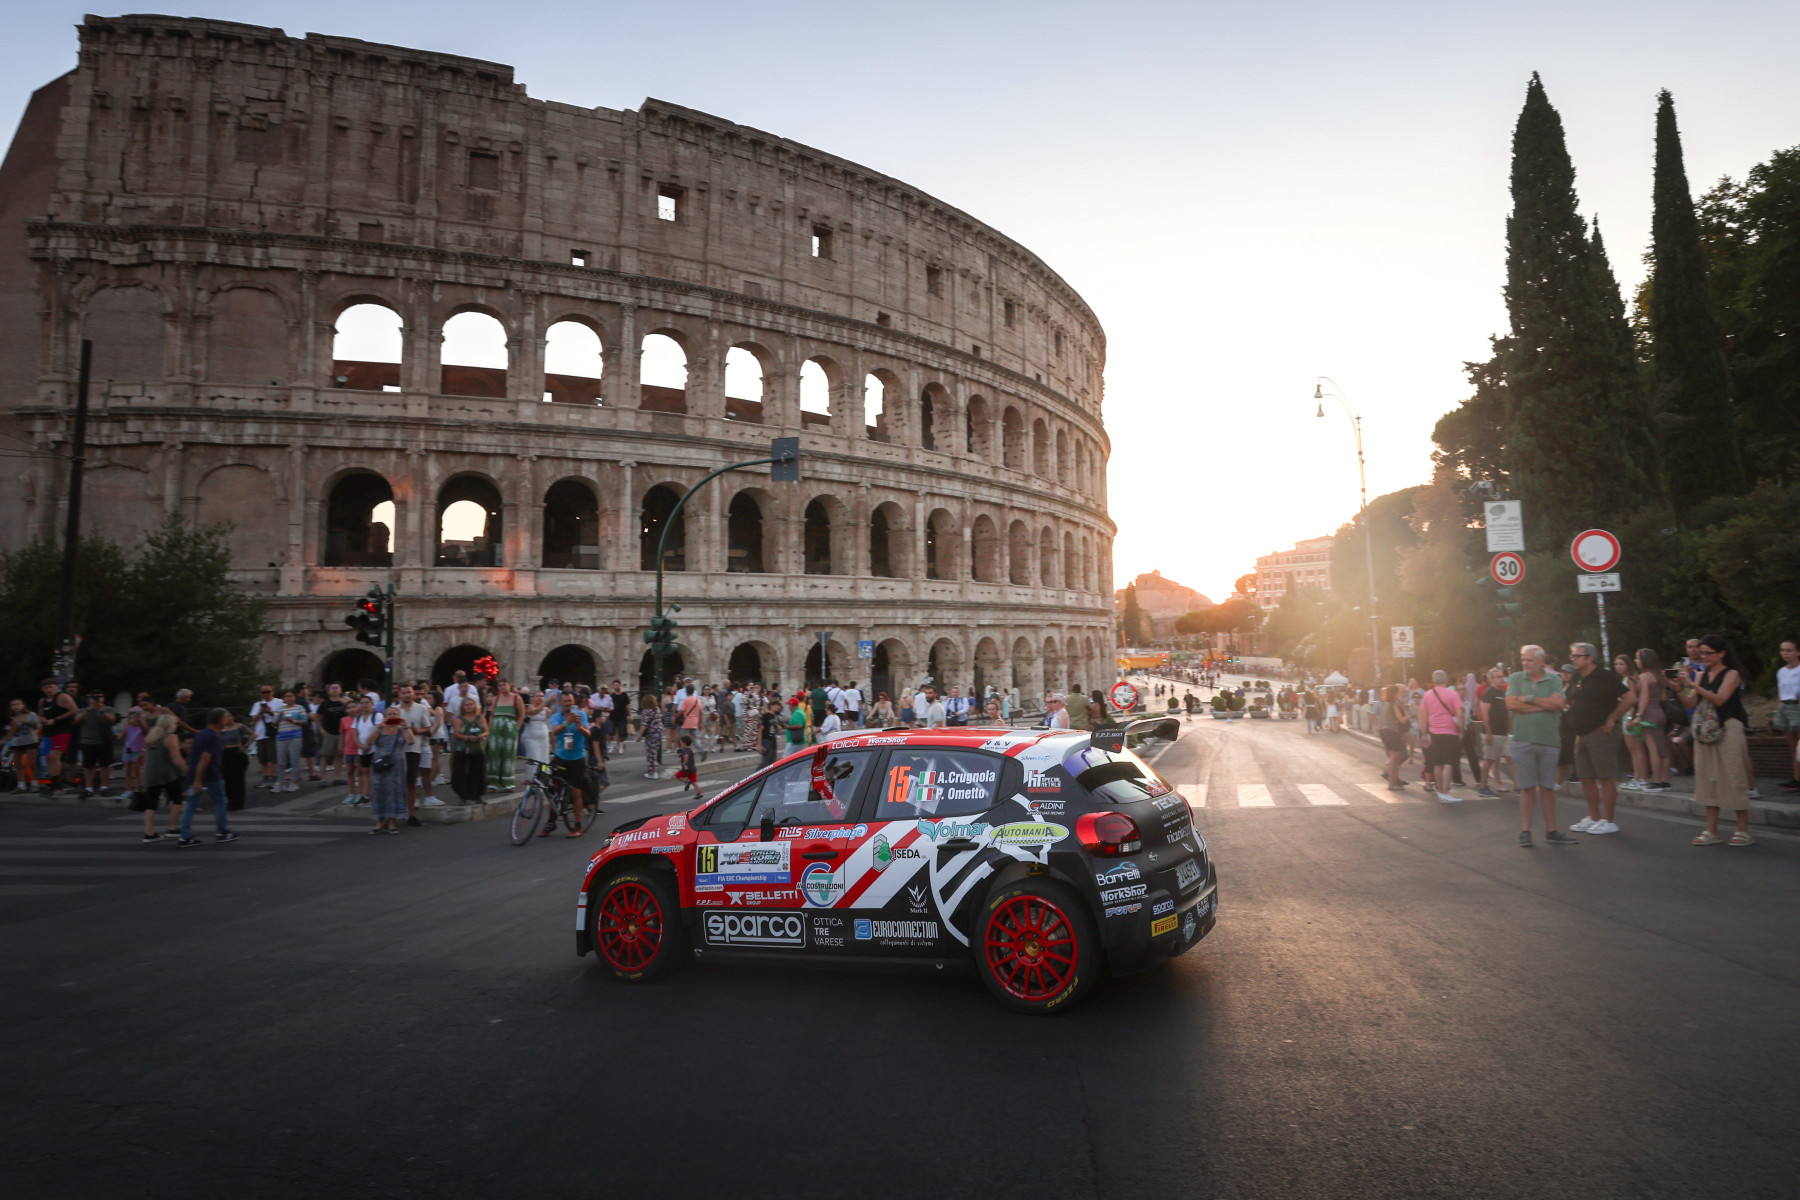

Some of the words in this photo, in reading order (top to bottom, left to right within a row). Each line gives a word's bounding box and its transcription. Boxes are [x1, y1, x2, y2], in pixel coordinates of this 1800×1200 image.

[1499, 561, 1518, 576] 30
[887, 766, 912, 802] 15
[935, 788, 944, 800] P.
[948, 787, 985, 800] Ometto
[804, 824, 866, 841] Silverphage
[918, 817, 989, 842] Volmar
[701, 846, 715, 873] 15
[894, 849, 921, 859] ISEDA
[736, 875, 767, 883] Championship
[746, 890, 798, 900] BELLETTI
[1152, 899, 1174, 915] sparco
[708, 915, 802, 943] sparco
[813, 918, 844, 927] OTTICA
[872, 921, 939, 939] EUROCONNECTION
[1154, 916, 1177, 934] PIRELLI
[814, 927, 830, 936] TRE
[814, 938, 844, 947] VARESE
